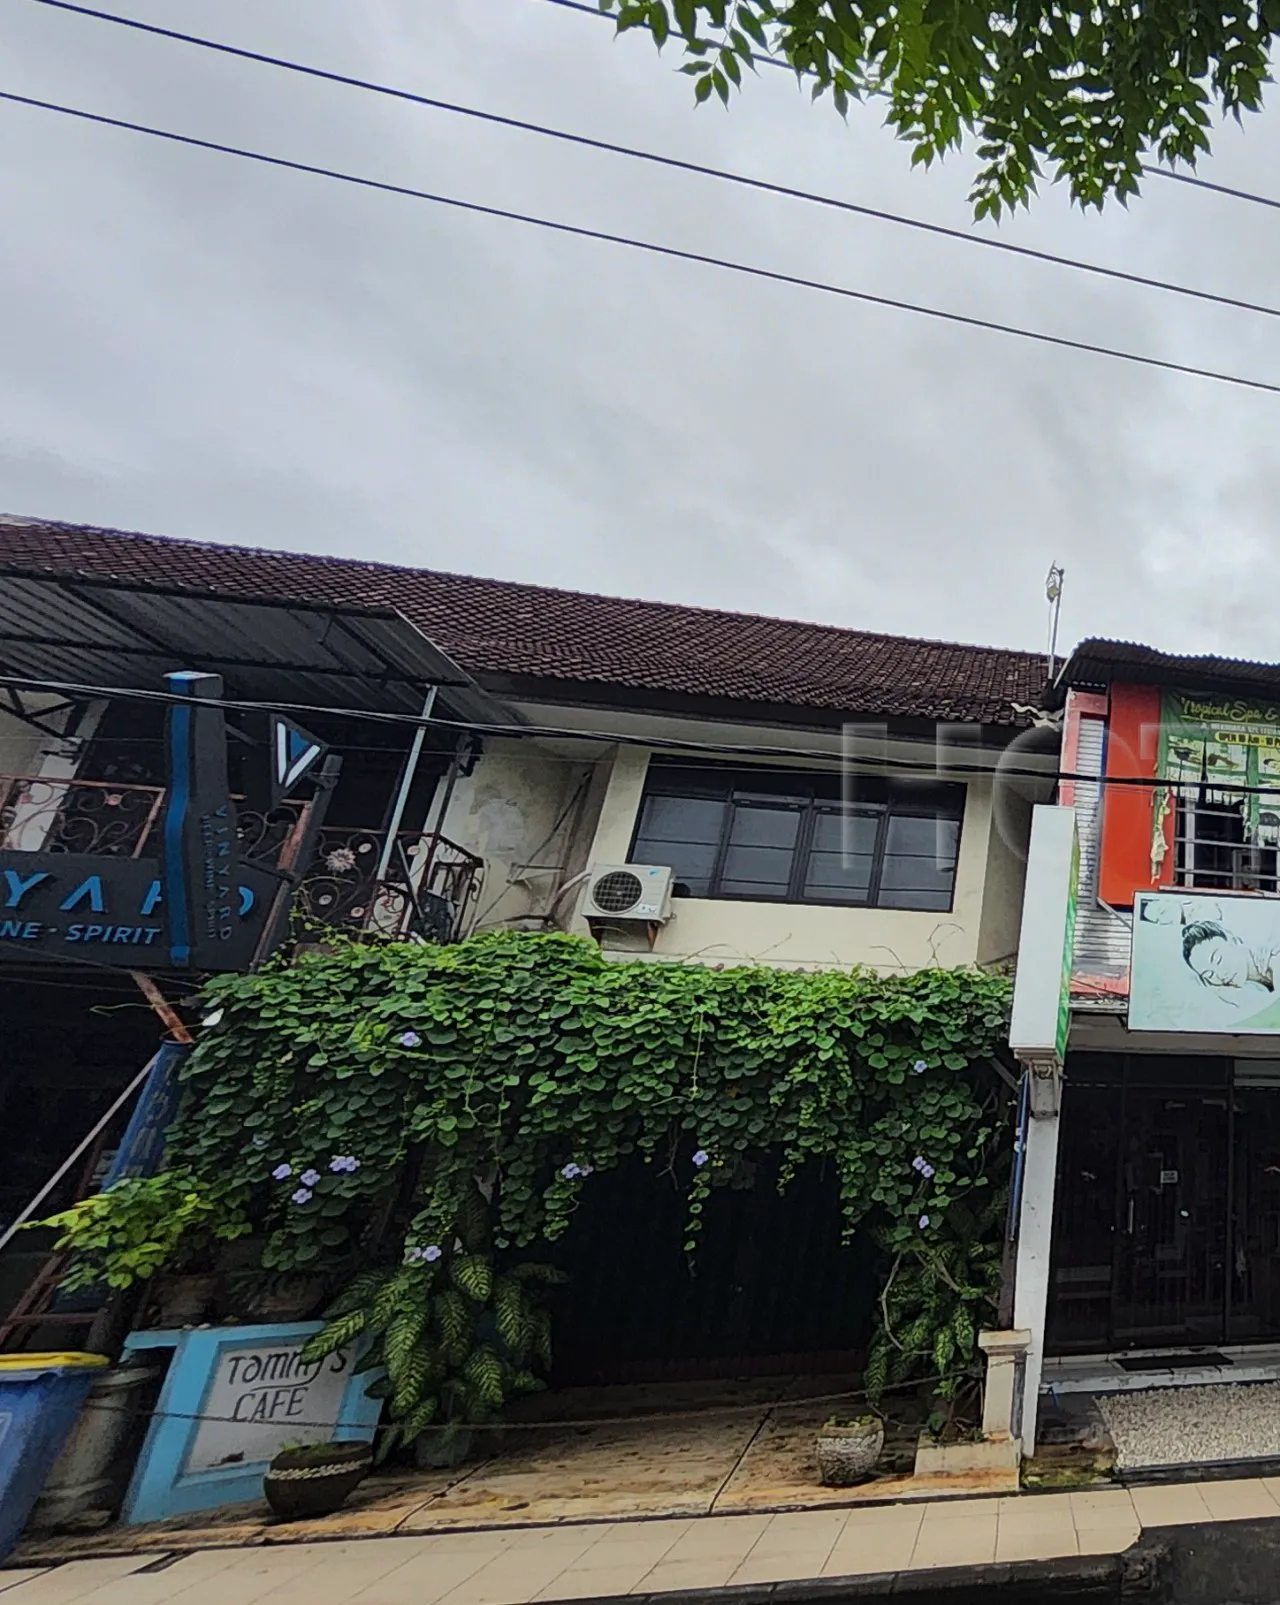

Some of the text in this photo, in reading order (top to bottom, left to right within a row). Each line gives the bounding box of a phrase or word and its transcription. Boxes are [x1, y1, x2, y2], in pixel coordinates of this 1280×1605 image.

[1180, 697, 1230, 720] Tropical
[1230, 700, 1262, 723] Spa
[1265, 707, 1279, 720] &
[1219, 733, 1236, 742] OPEN
[65, 923, 162, 945] SPIRIT
[230, 1387, 309, 1423] CAFE
